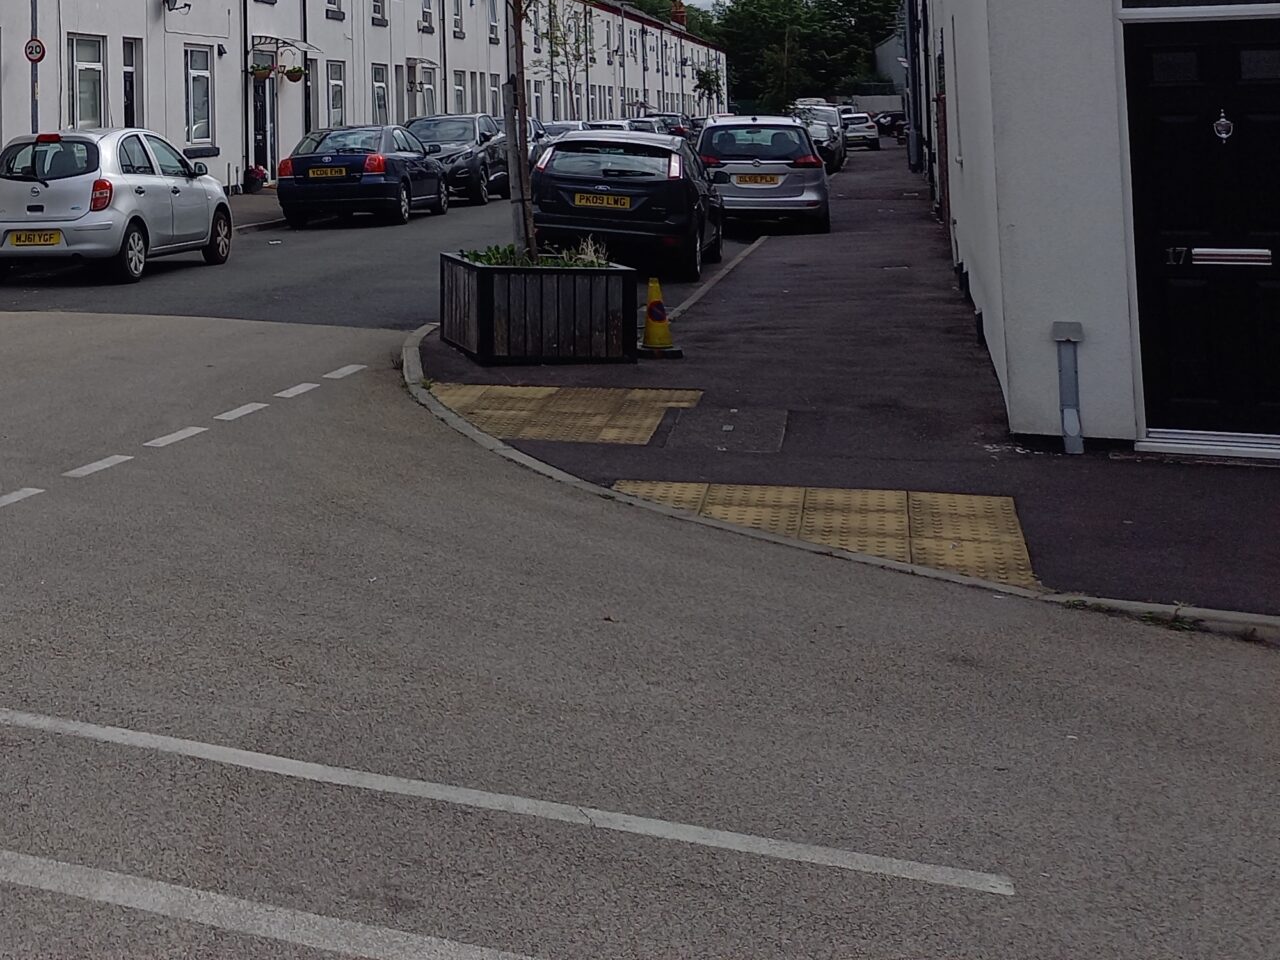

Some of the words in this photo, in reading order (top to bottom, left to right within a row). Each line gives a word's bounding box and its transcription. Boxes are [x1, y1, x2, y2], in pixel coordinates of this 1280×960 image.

[28, 45, 41, 55] 20
[579, 194, 605, 205] PK09
[37, 233, 55, 243] YGF
[1165, 247, 1187, 265] 17
